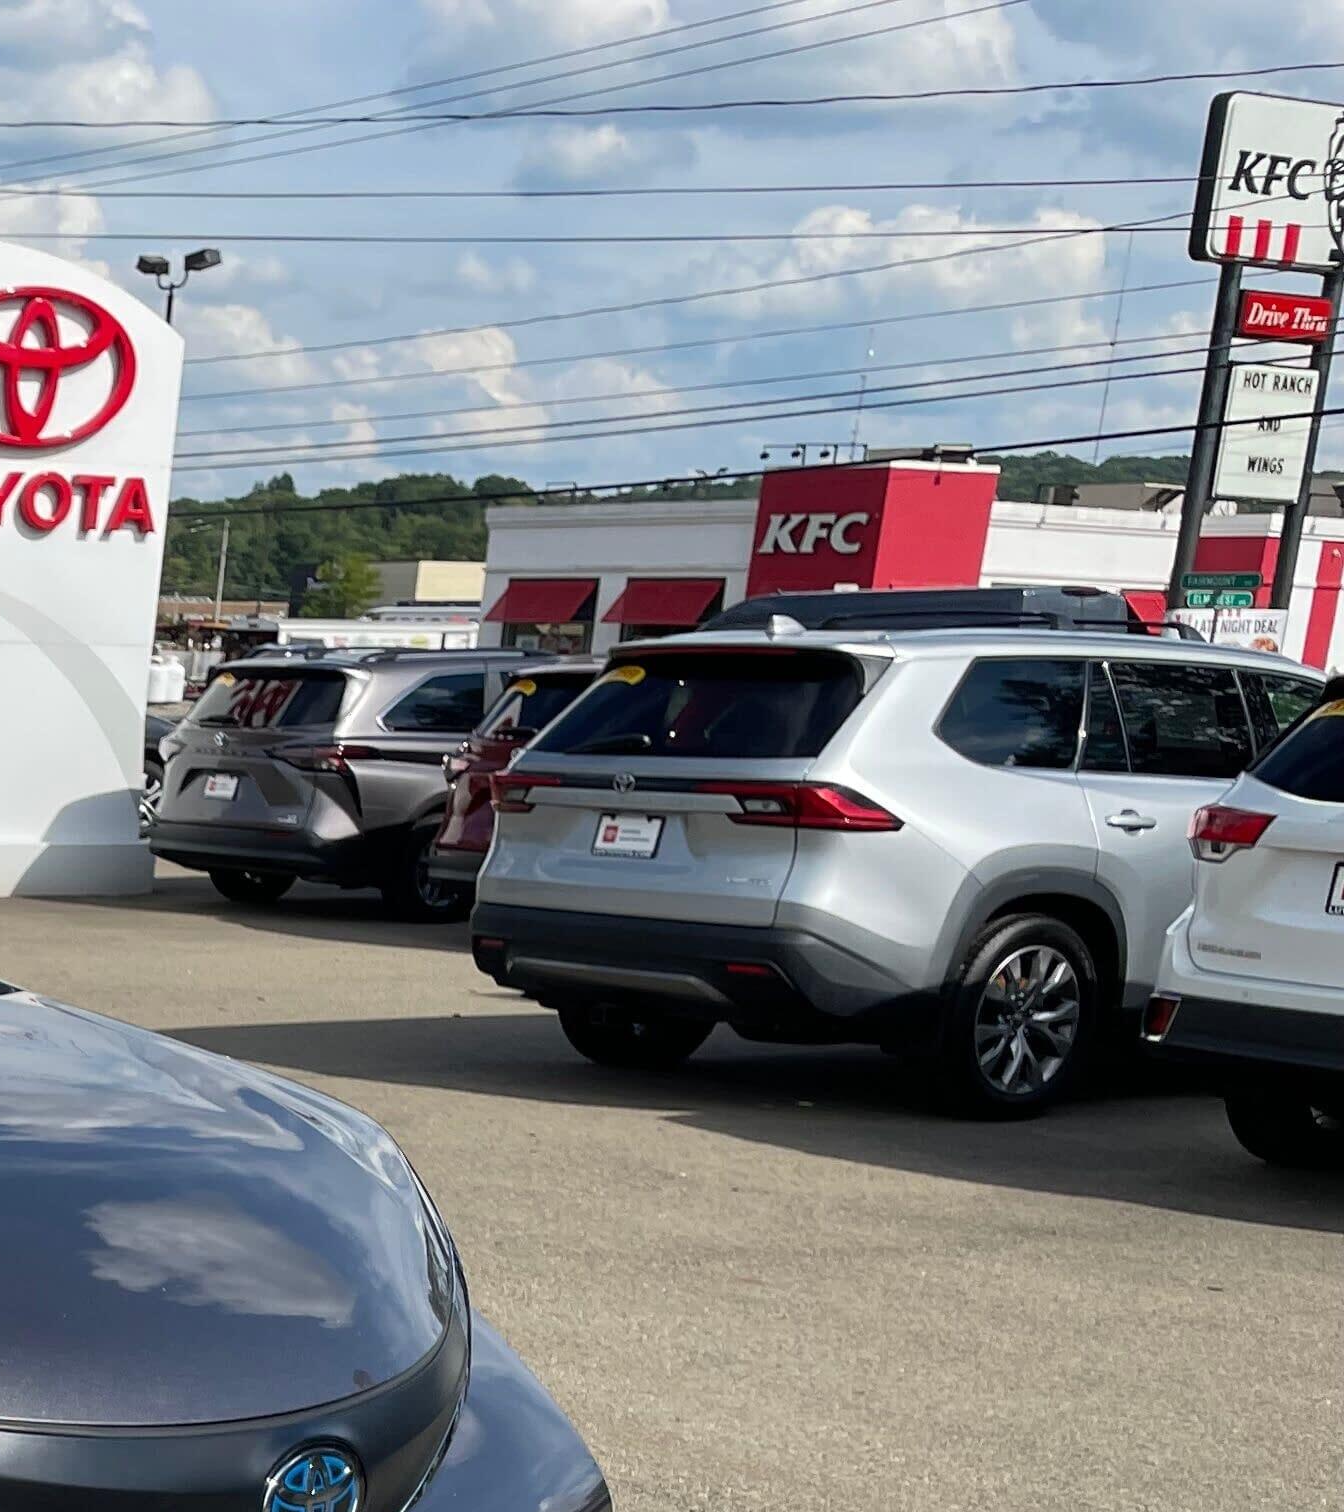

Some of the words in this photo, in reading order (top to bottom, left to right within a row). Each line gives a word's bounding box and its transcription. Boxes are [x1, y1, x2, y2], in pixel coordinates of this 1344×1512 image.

[1228, 150, 1316, 199] KFC
[1247, 302, 1289, 327] Drive
[1291, 306, 1328, 333] Thru
[1244, 371, 1266, 390] HOT
[1273, 373, 1313, 395] RANCH
[1247, 455, 1285, 475] WINGS
[759, 512, 869, 554] KFC
[1219, 618, 1252, 633] NIGHT
[1254, 619, 1278, 634] DEAL
